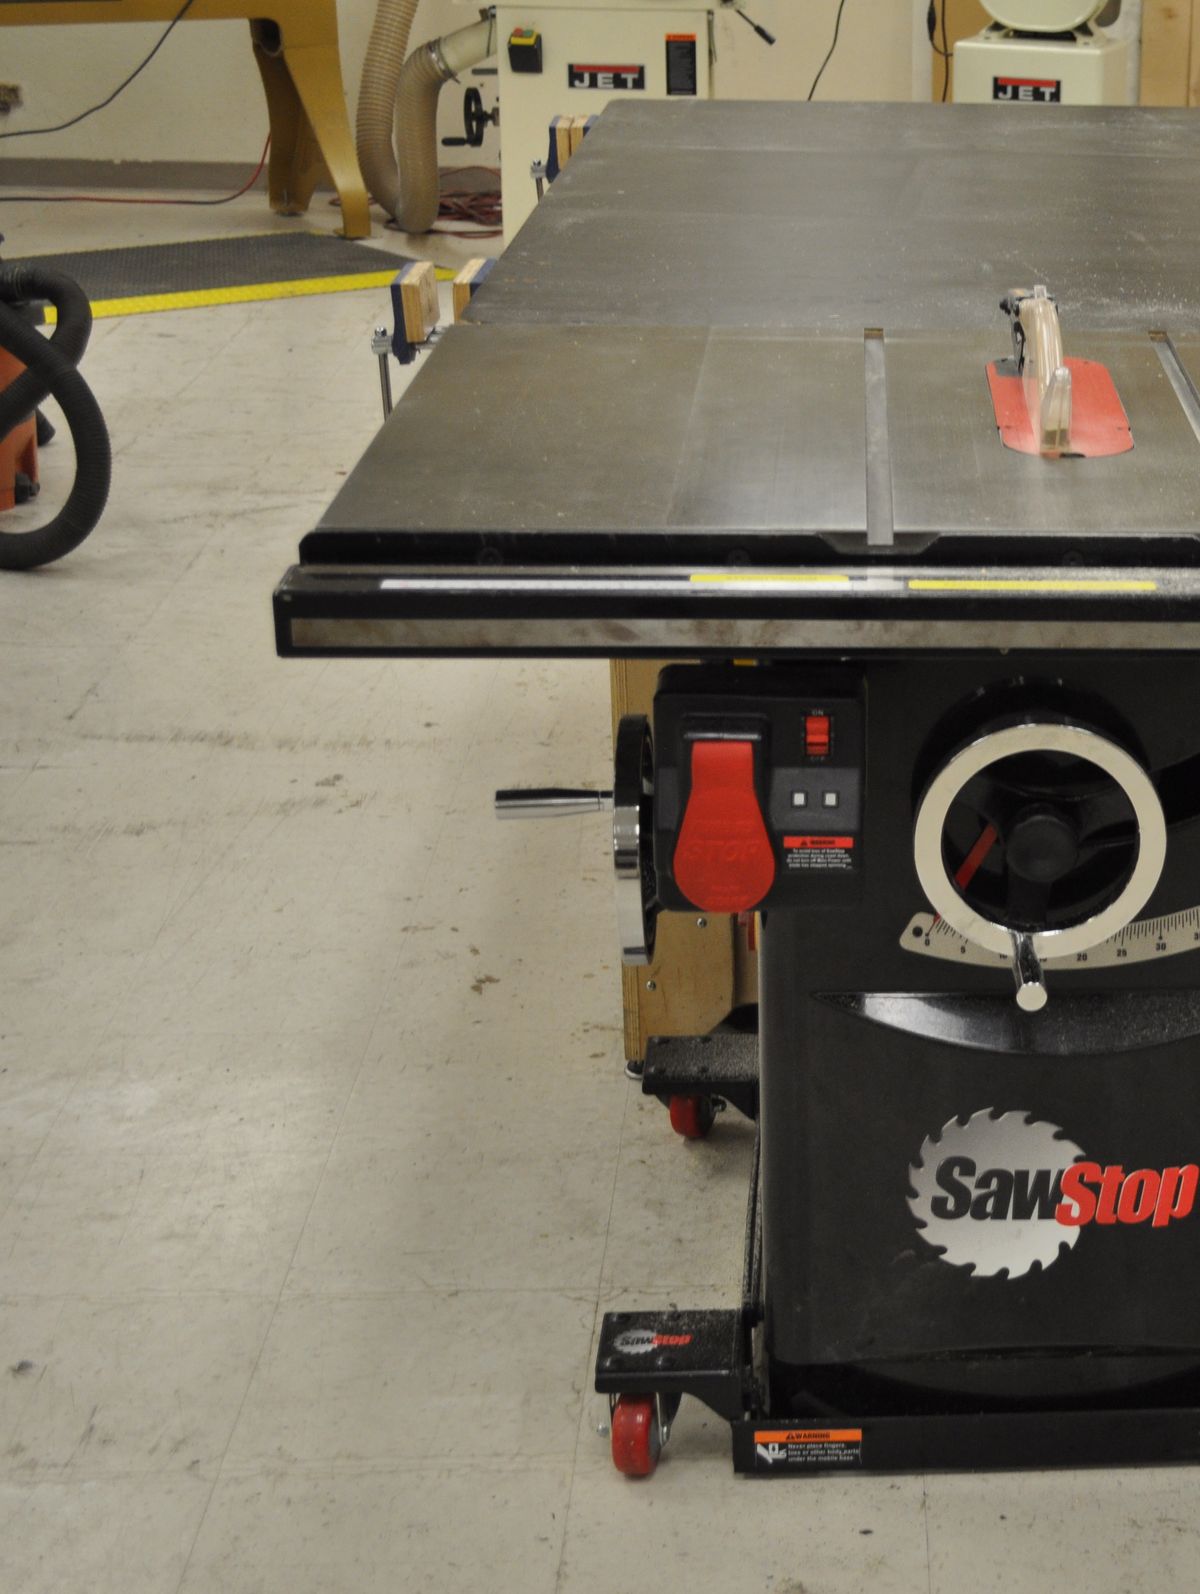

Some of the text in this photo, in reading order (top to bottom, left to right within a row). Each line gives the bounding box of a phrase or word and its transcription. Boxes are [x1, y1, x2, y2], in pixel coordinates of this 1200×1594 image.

[574, 72, 639, 88] JET
[998, 86, 1056, 101] JET
[1076, 953, 1087, 962] 20
[1117, 949, 1127, 957] 25
[1156, 943, 1166, 951] 30
[931, 1156, 1199, 1227] SawStop
